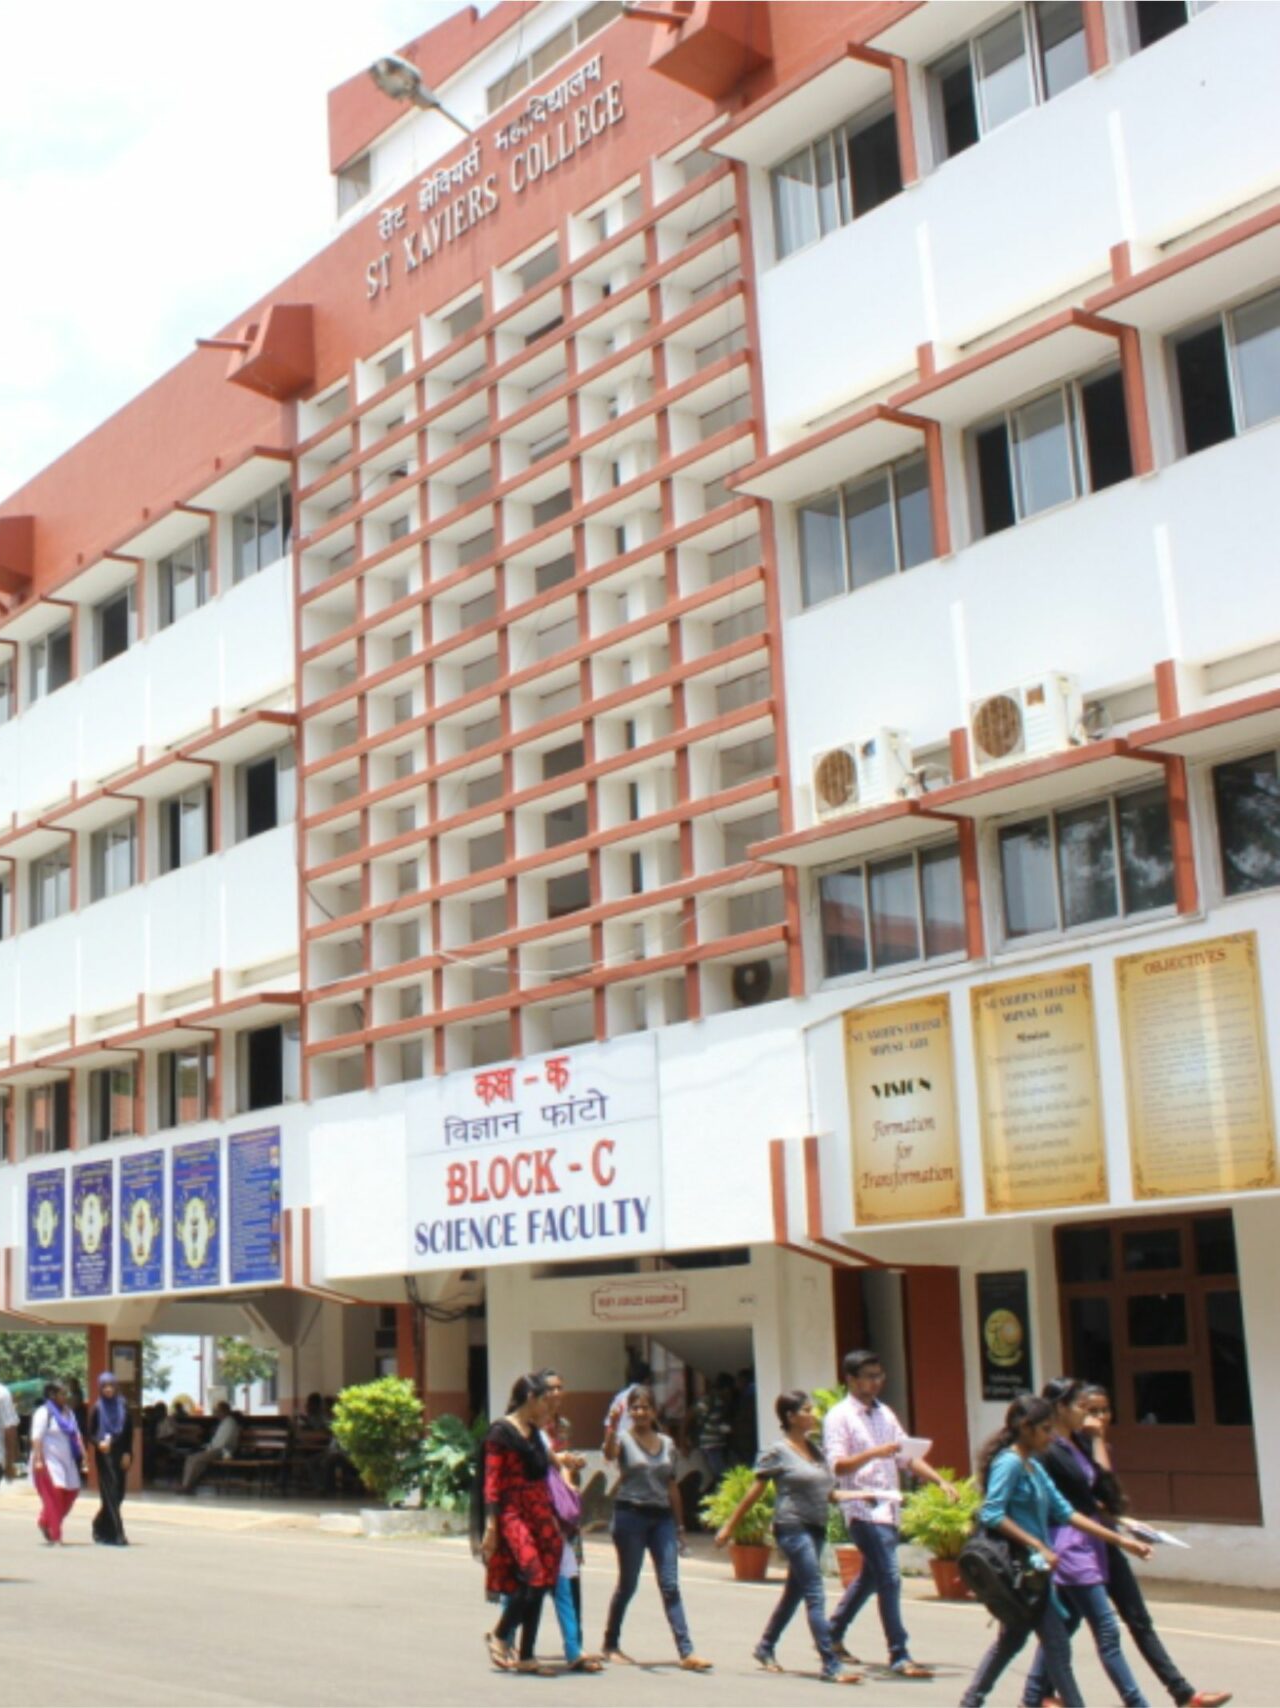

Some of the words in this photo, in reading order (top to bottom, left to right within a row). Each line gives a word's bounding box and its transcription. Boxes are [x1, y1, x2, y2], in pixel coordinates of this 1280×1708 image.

[365, 252, 391, 300] ST
[403, 173, 499, 273] XAVIERS
[511, 81, 624, 193] COLLEGE
[1143, 948, 1227, 976] OBJECTIVES
[444, 1111, 520, 1146] विज्ञान
[540, 1088, 608, 1128] फांटो
[871, 1078, 931, 1099] VISION
[447, 1148, 560, 1206] BLOCK
[568, 1163, 582, 1172] -
[591, 1139, 616, 1188] C
[414, 1212, 518, 1255] SCIENCE
[527, 1195, 651, 1245] FACULTY
